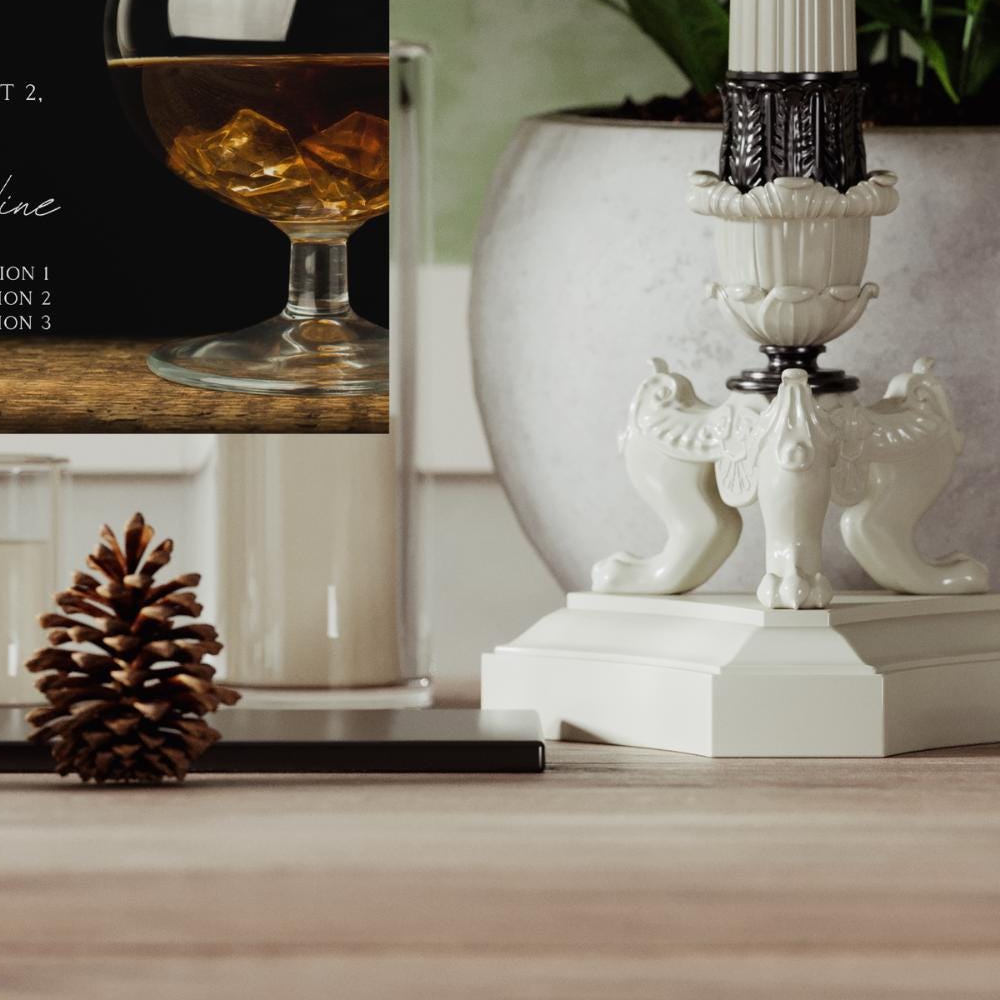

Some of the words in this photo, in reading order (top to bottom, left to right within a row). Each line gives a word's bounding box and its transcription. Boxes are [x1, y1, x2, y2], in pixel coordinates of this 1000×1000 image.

[25, 83, 43, 103] 2,
[41, 290, 51, 306] 2
[41, 314, 52, 330] 3
